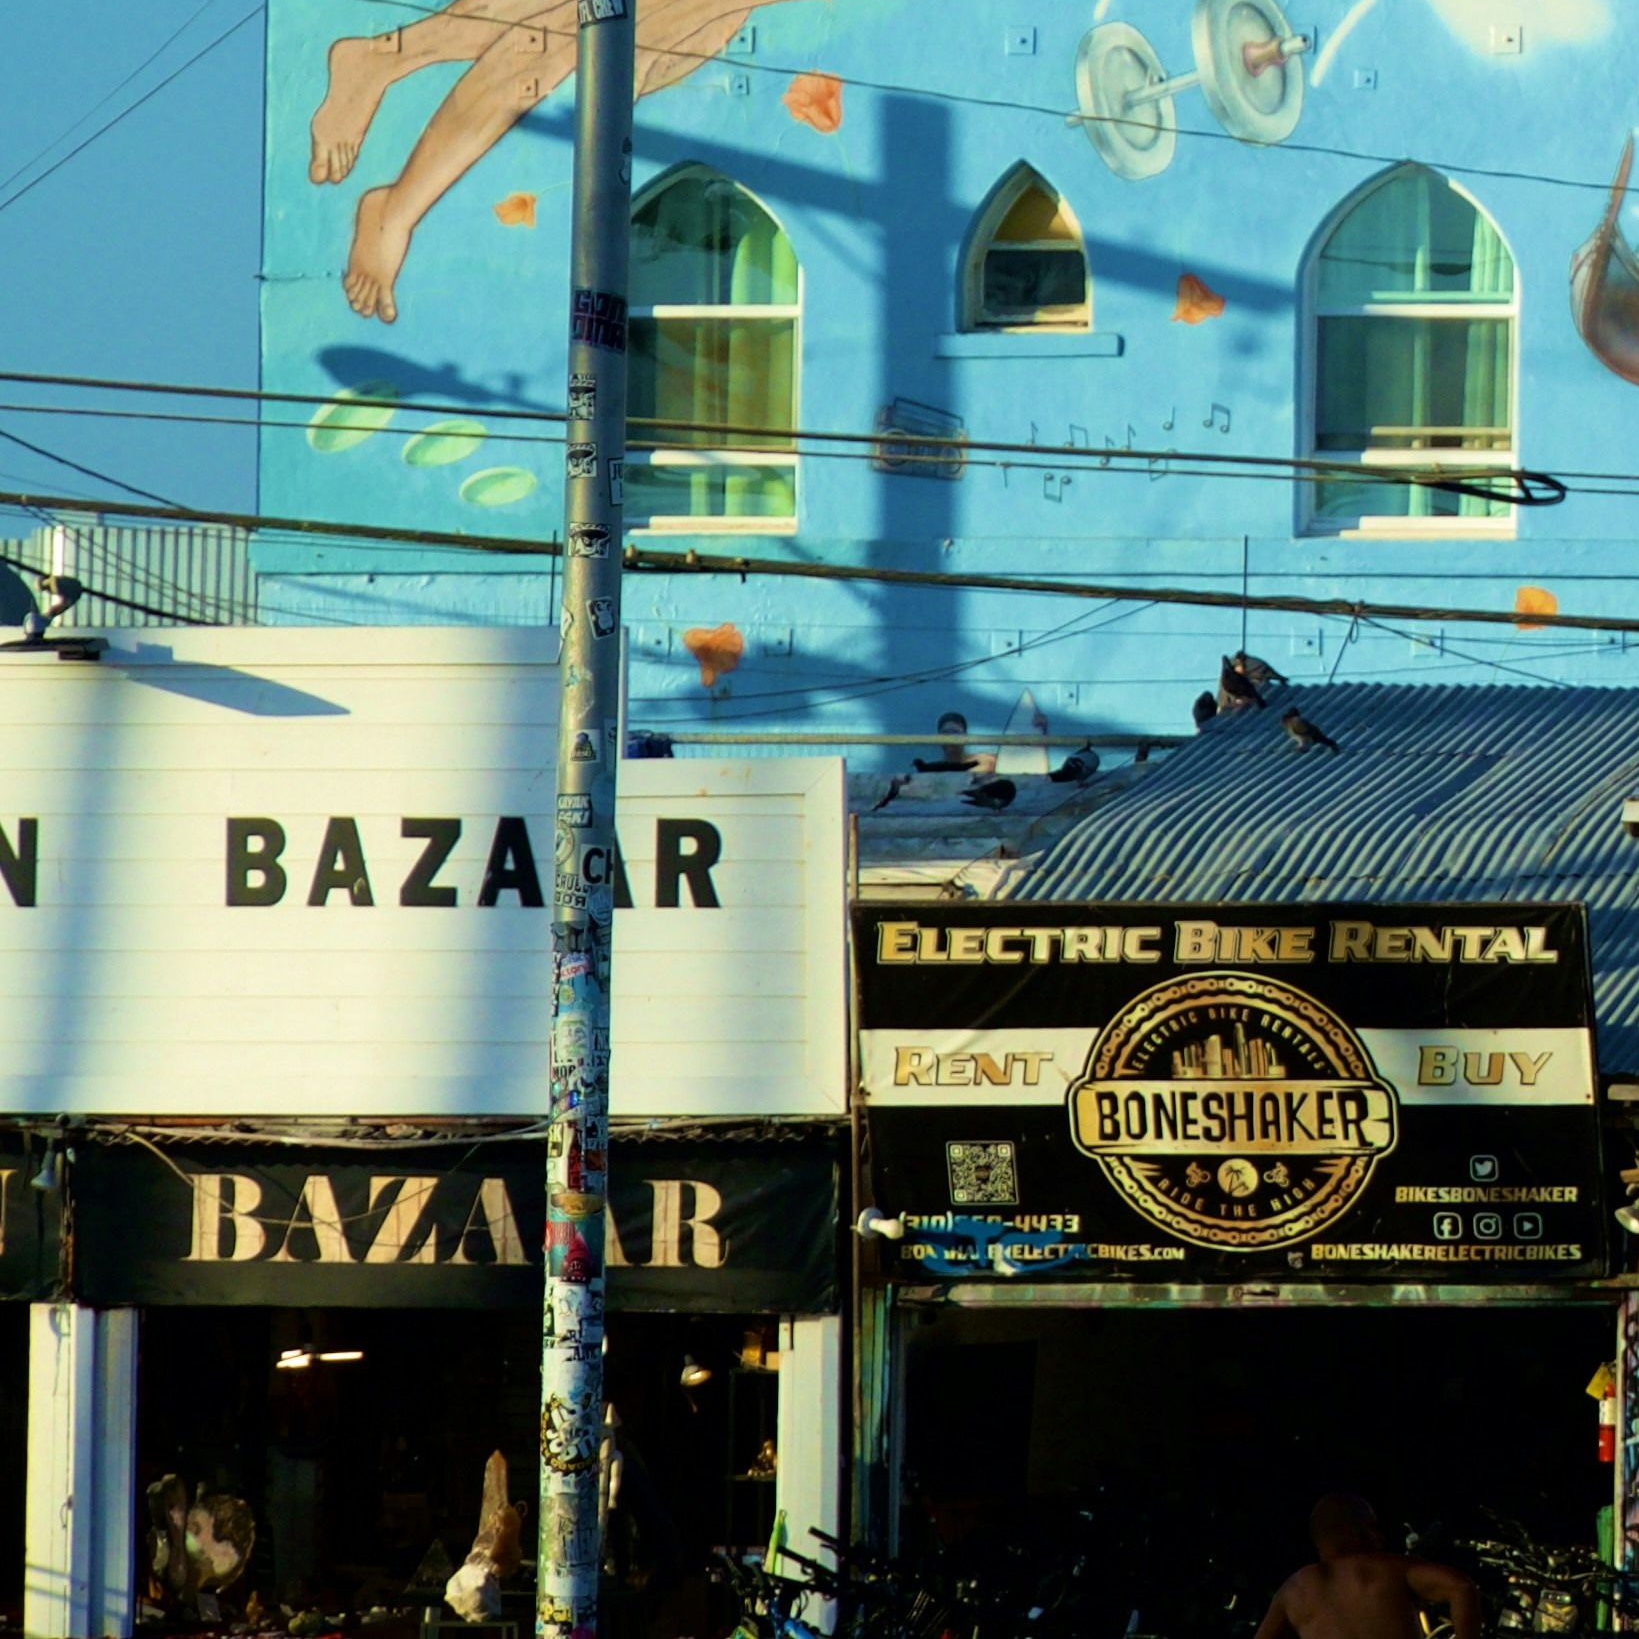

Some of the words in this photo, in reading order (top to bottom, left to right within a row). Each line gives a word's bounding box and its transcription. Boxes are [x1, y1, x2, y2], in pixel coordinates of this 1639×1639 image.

[226, 816, 722, 908] BAZAR
[877, 921, 1162, 965] ELECTRIC
[1173, 920, 1316, 964] BIKE
[1329, 920, 1558, 964] RENTAL
[1132, 1011, 1199, 1070] ELECTRIC
[1208, 1006, 1249, 1023] BIKE
[1260, 1012, 1325, 1070] RENTALS
[894, 1046, 1054, 1086] RENT
[1417, 1045, 1553, 1086] BUY
[1095, 1090, 1374, 1148] BONESHAKER
[1219, 1203, 1258, 1219] THE
[1395, 1186, 1579, 1204] BIKESBONESHAKER
[1311, 1242, 1583, 1262] BONESHAKERELECTRICBIKES
